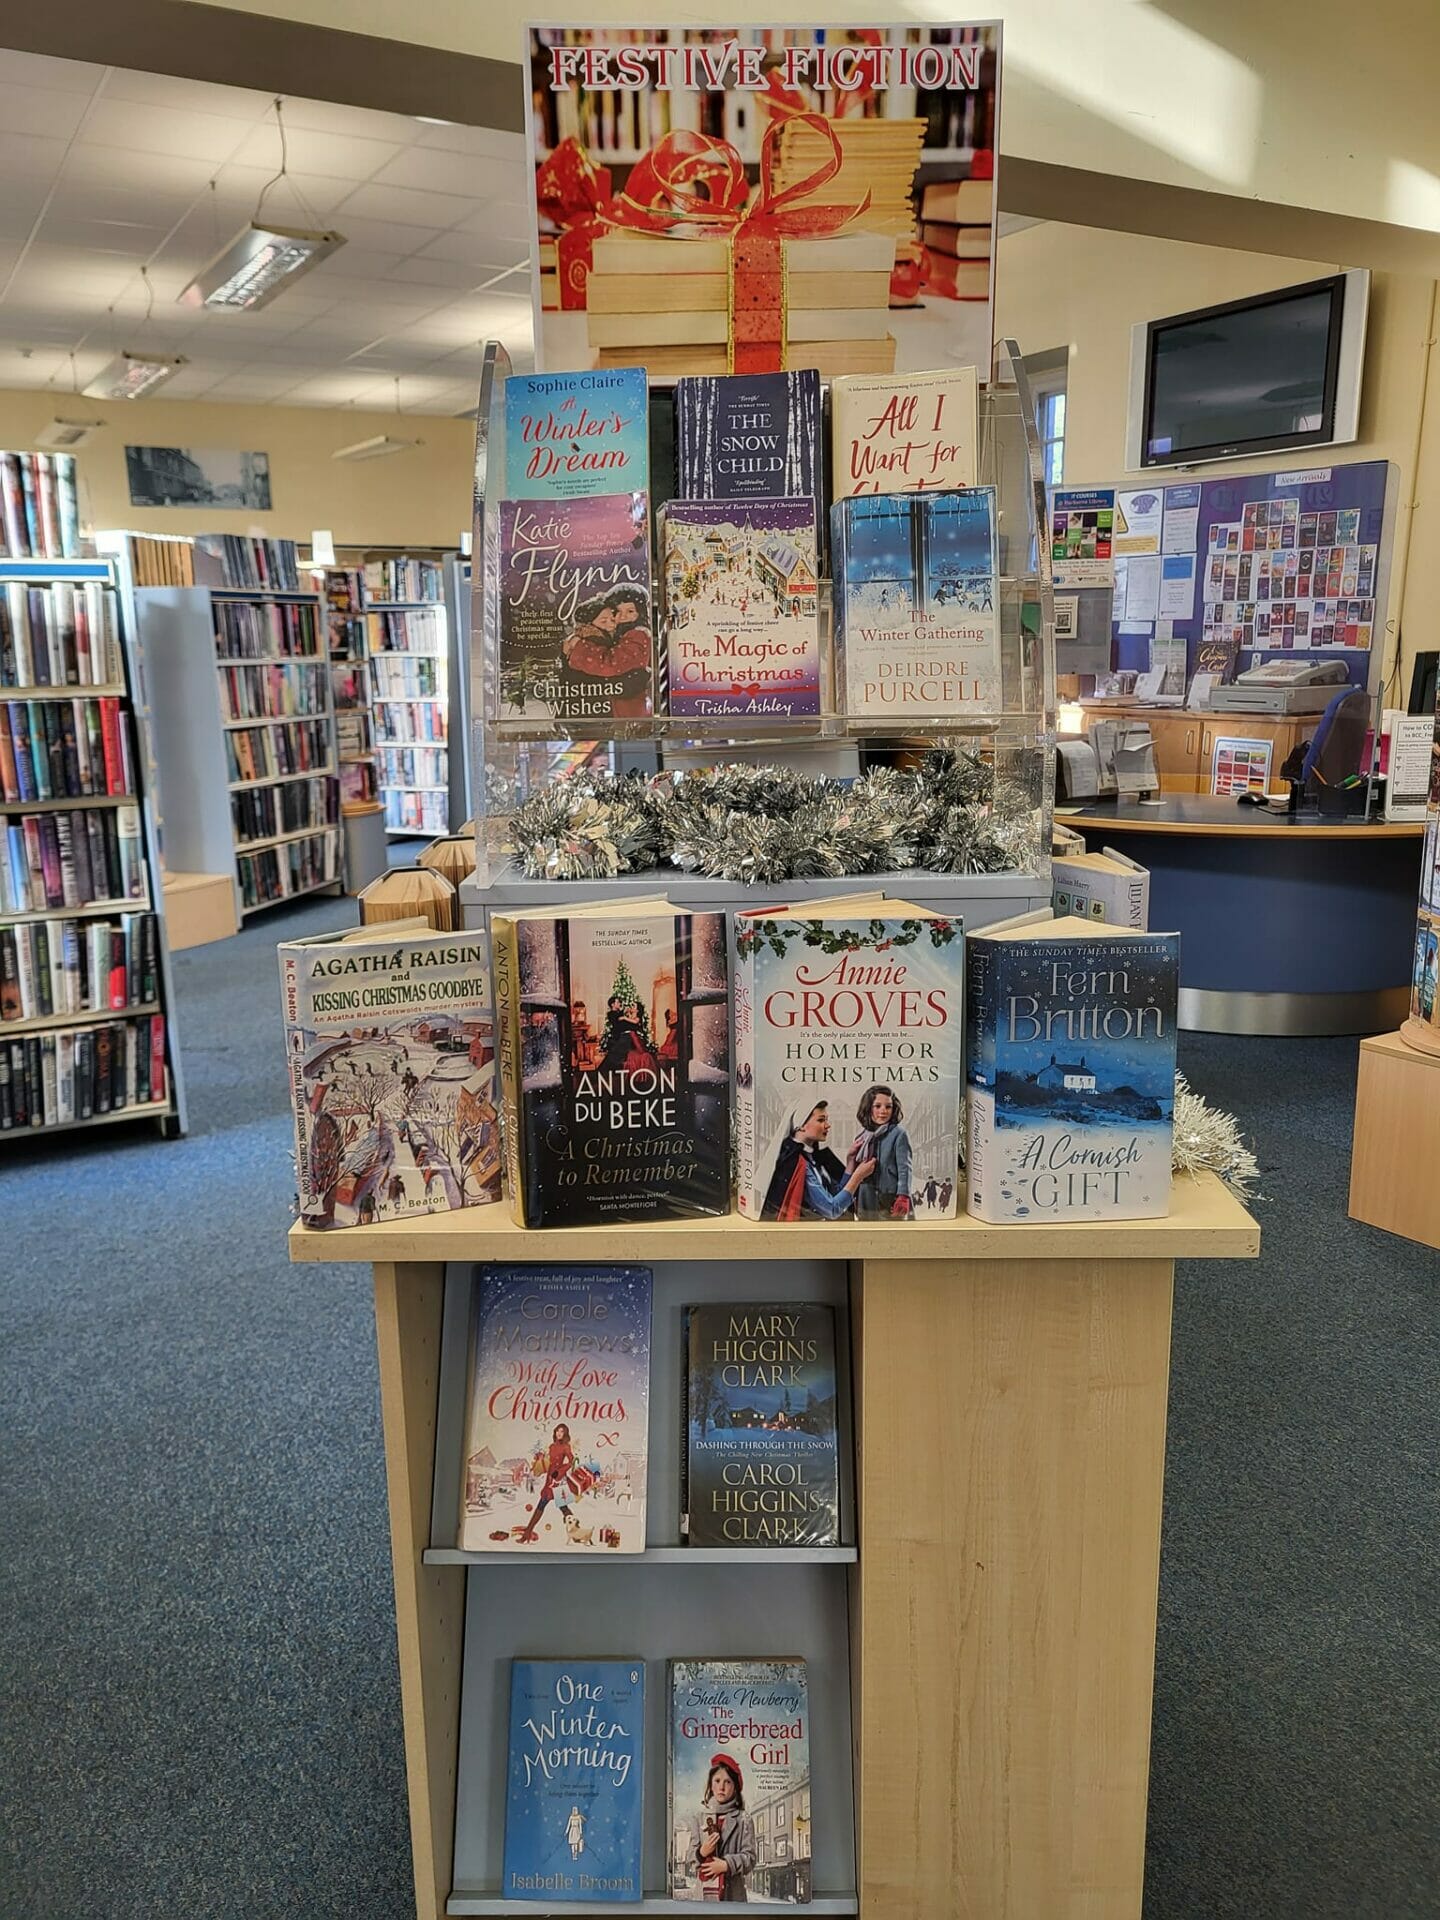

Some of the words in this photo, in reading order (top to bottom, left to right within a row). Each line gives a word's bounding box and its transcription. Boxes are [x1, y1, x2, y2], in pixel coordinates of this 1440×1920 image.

[549, 38, 768, 92] FESTIVE
[782, 45, 984, 91] FICTION
[527, 379, 577, 395] Sophie
[580, 376, 624, 390] Claire
[560, 396, 576, 412] A
[862, 394, 919, 440] All
[931, 394, 947, 431] I
[520, 408, 632, 443] Winter's
[728, 413, 773, 429] THE
[721, 435, 781, 452] SNOW
[526, 446, 630, 480] Dream
[717, 457, 784, 474] CHILD
[851, 440, 931, 479] Want
[925, 440, 961, 474] for
[754, 502, 769, 510] Days
[770, 502, 776, 510] of
[777, 501, 809, 509] Christmas
[511, 507, 572, 548] Katie
[510, 544, 640, 621] Flynn
[907, 610, 936, 623] The
[860, 629, 910, 642] Winter
[914, 626, 985, 642] Gathering
[678, 642, 711, 658] The
[714, 635, 788, 664] Magic
[792, 641, 808, 655] of
[682, 661, 804, 684] Christmas
[878, 661, 969, 678] DEIRDRE
[533, 681, 624, 699] Christmas
[864, 679, 985, 703] PURCELL
[546, 699, 612, 717] Wishes
[695, 699, 743, 715] Trisha
[745, 697, 794, 717] Ashley
[591, 939, 628, 947] BESTSELLING
[628, 938, 652, 946] AUTHOR
[607, 929, 630, 937] SUNDAY
[311, 952, 404, 977] AGATHA
[410, 946, 482, 967] RAISIN
[1010, 949, 1030, 957] THE
[1032, 947, 1075, 956] SUNDAY
[1076, 946, 1108, 956] TIMES
[1110, 945, 1168, 955] BESTSELLER
[285, 959, 295, 972] M.
[391, 972, 410, 982] and
[497, 940, 510, 1011] ANTON
[795, 954, 907, 986] Annie
[973, 953, 990, 997] Fern
[1050, 961, 1131, 996] Fern
[286, 974, 296, 985] C.
[287, 986, 297, 1022] Beaton
[312, 989, 360, 1012] KISSING
[362, 984, 426, 1008] CHRISTMAS
[428, 978, 483, 1001] GOODBYE
[326, 1013, 355, 1023] Agatha
[356, 1010, 381, 1019] Raisin
[382, 1006, 422, 1017] Cotswolds
[424, 1003, 451, 1011] murder
[743, 987, 752, 1034] Annie
[764, 989, 948, 1028] GROVES
[1007, 995, 1166, 1044] Britton
[823, 1031, 838, 1039] only
[839, 1031, 856, 1039] place
[857, 1031, 872, 1039] they
[500, 1038, 513, 1082] BEKE
[786, 1043, 866, 1059] HOME
[882, 1042, 934, 1059] FOR
[575, 1067, 676, 1098] ANTON
[781, 1066, 939, 1082] CHRISTMAS
[575, 1102, 602, 1123] DU
[610, 1098, 676, 1130] BEKE
[974, 1099, 986, 1110] A
[744, 1102, 753, 1156] HOME
[974, 1109, 986, 1151] Cornish
[546, 1125, 574, 1161] A
[584, 1131, 695, 1160] Christmas
[1022, 1134, 1045, 1171] A
[1049, 1134, 1143, 1170] Cornish
[299, 1143, 310, 1178] CHRISTMAS
[557, 1169, 578, 1186] to
[584, 1159, 698, 1186] Remember
[973, 1151, 983, 1187] GIFT
[744, 1159, 753, 1191] FOR
[1031, 1170, 1130, 1208] GIFT
[379, 1203, 391, 1213] M.
[394, 1200, 406, 1210] C.
[408, 1195, 446, 1208] Beaton
[520, 1294, 609, 1321] Carole
[495, 1324, 634, 1354] Matthews
[728, 1316, 800, 1337] MARY
[712, 1340, 817, 1362] HIGGINS
[506, 1359, 560, 1391] With
[557, 1358, 618, 1391] Love
[722, 1365, 807, 1387] CLARK
[488, 1384, 629, 1422] Christmas
[534, 1385, 548, 1398] at
[696, 1441, 737, 1450] DASHING
[740, 1441, 785, 1450] THROUGH
[787, 1441, 805, 1449] THE
[807, 1441, 833, 1449] SNOW
[722, 1463, 809, 1486] CAROL
[712, 1490, 820, 1513] HIGGINS
[723, 1517, 809, 1541] CLARK
[556, 1675, 604, 1705] One
[687, 1687, 730, 1706] Sheila
[733, 1687, 800, 1713] Newberry
[521, 1706, 630, 1745] Winter
[711, 1706, 734, 1719] The
[681, 1717, 803, 1744] Gingerbread
[524, 1742, 632, 1788] Morning
[750, 1743, 789, 1765] Girl
[512, 1872, 573, 1890] Isabelle
[579, 1873, 634, 1891] Broom
